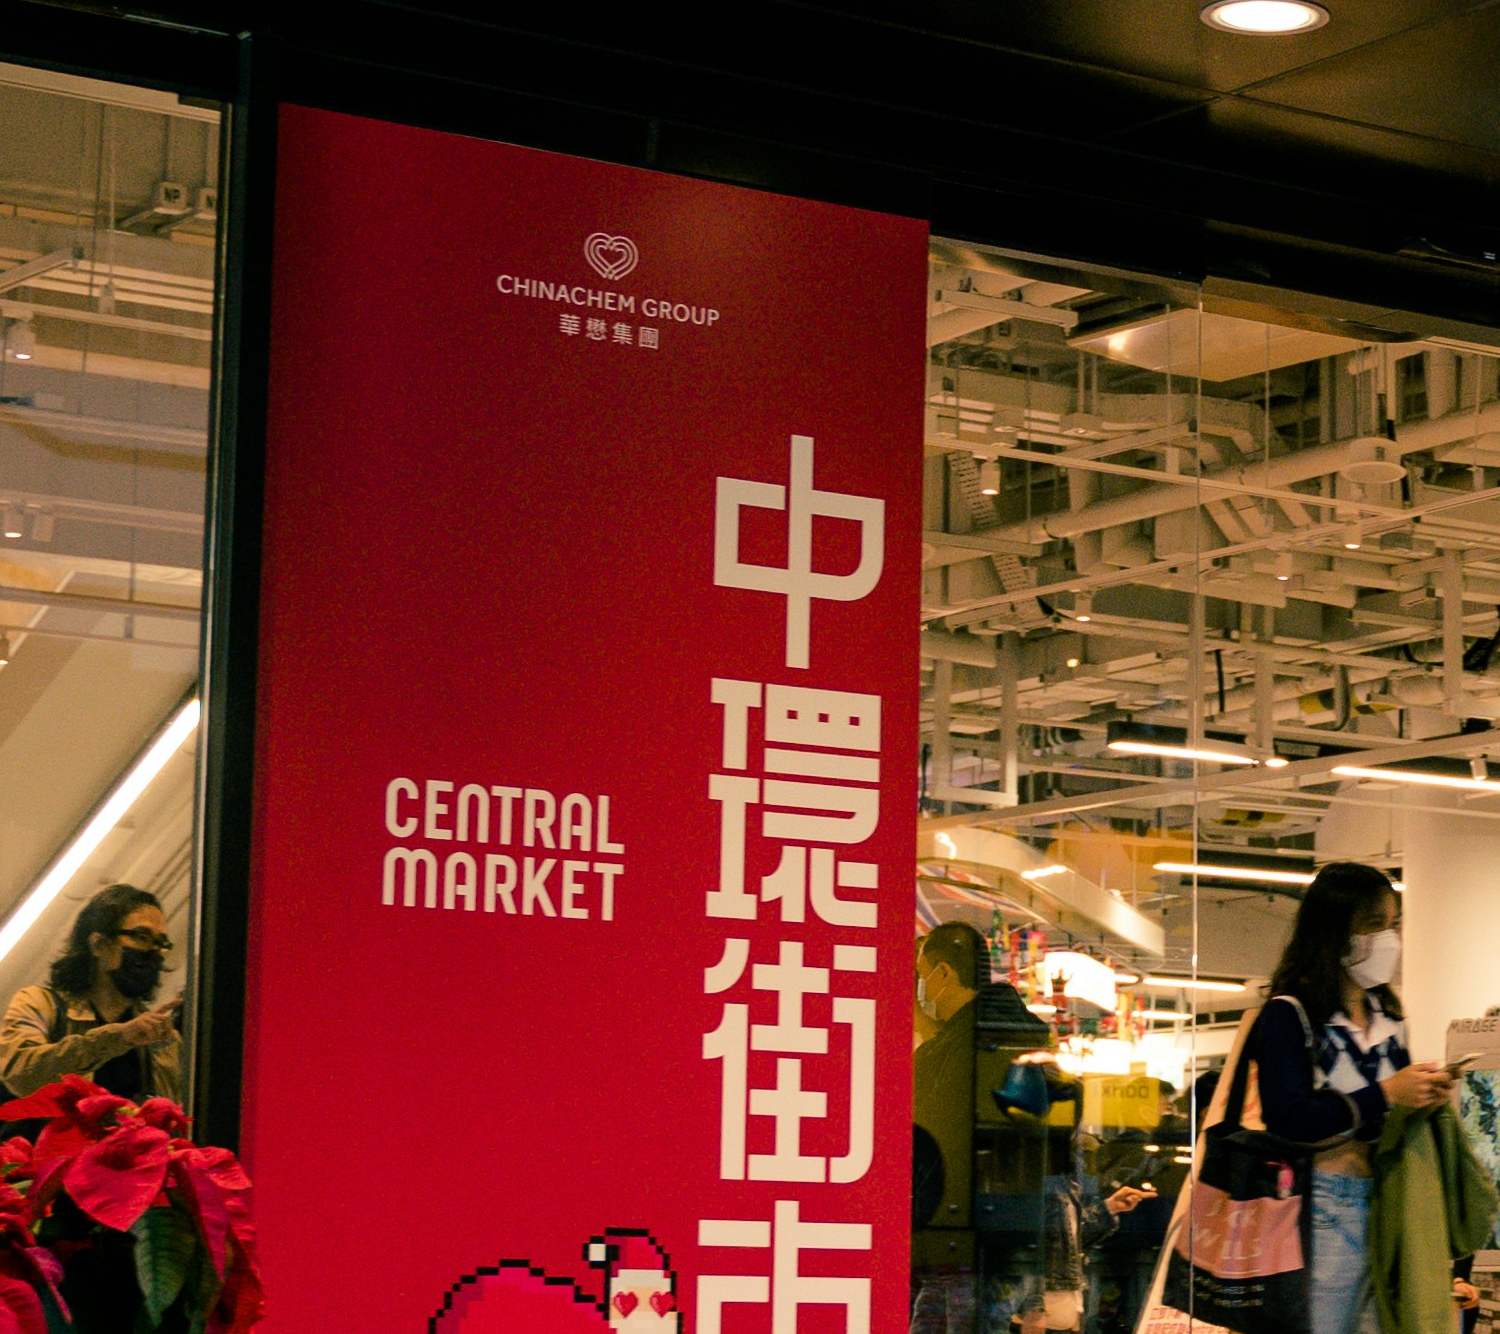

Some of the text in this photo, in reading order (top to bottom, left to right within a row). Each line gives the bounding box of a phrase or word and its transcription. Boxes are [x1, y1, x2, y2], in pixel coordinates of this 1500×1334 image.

[496, 273, 721, 328] CHINACHEM GROUP
[558, 312, 660, 350] 華懋集團
[384, 777, 625, 855] CENTRAL
[381, 846, 625, 921] MARKET
[1451, 1018, 1498, 1034] MIRAGE
